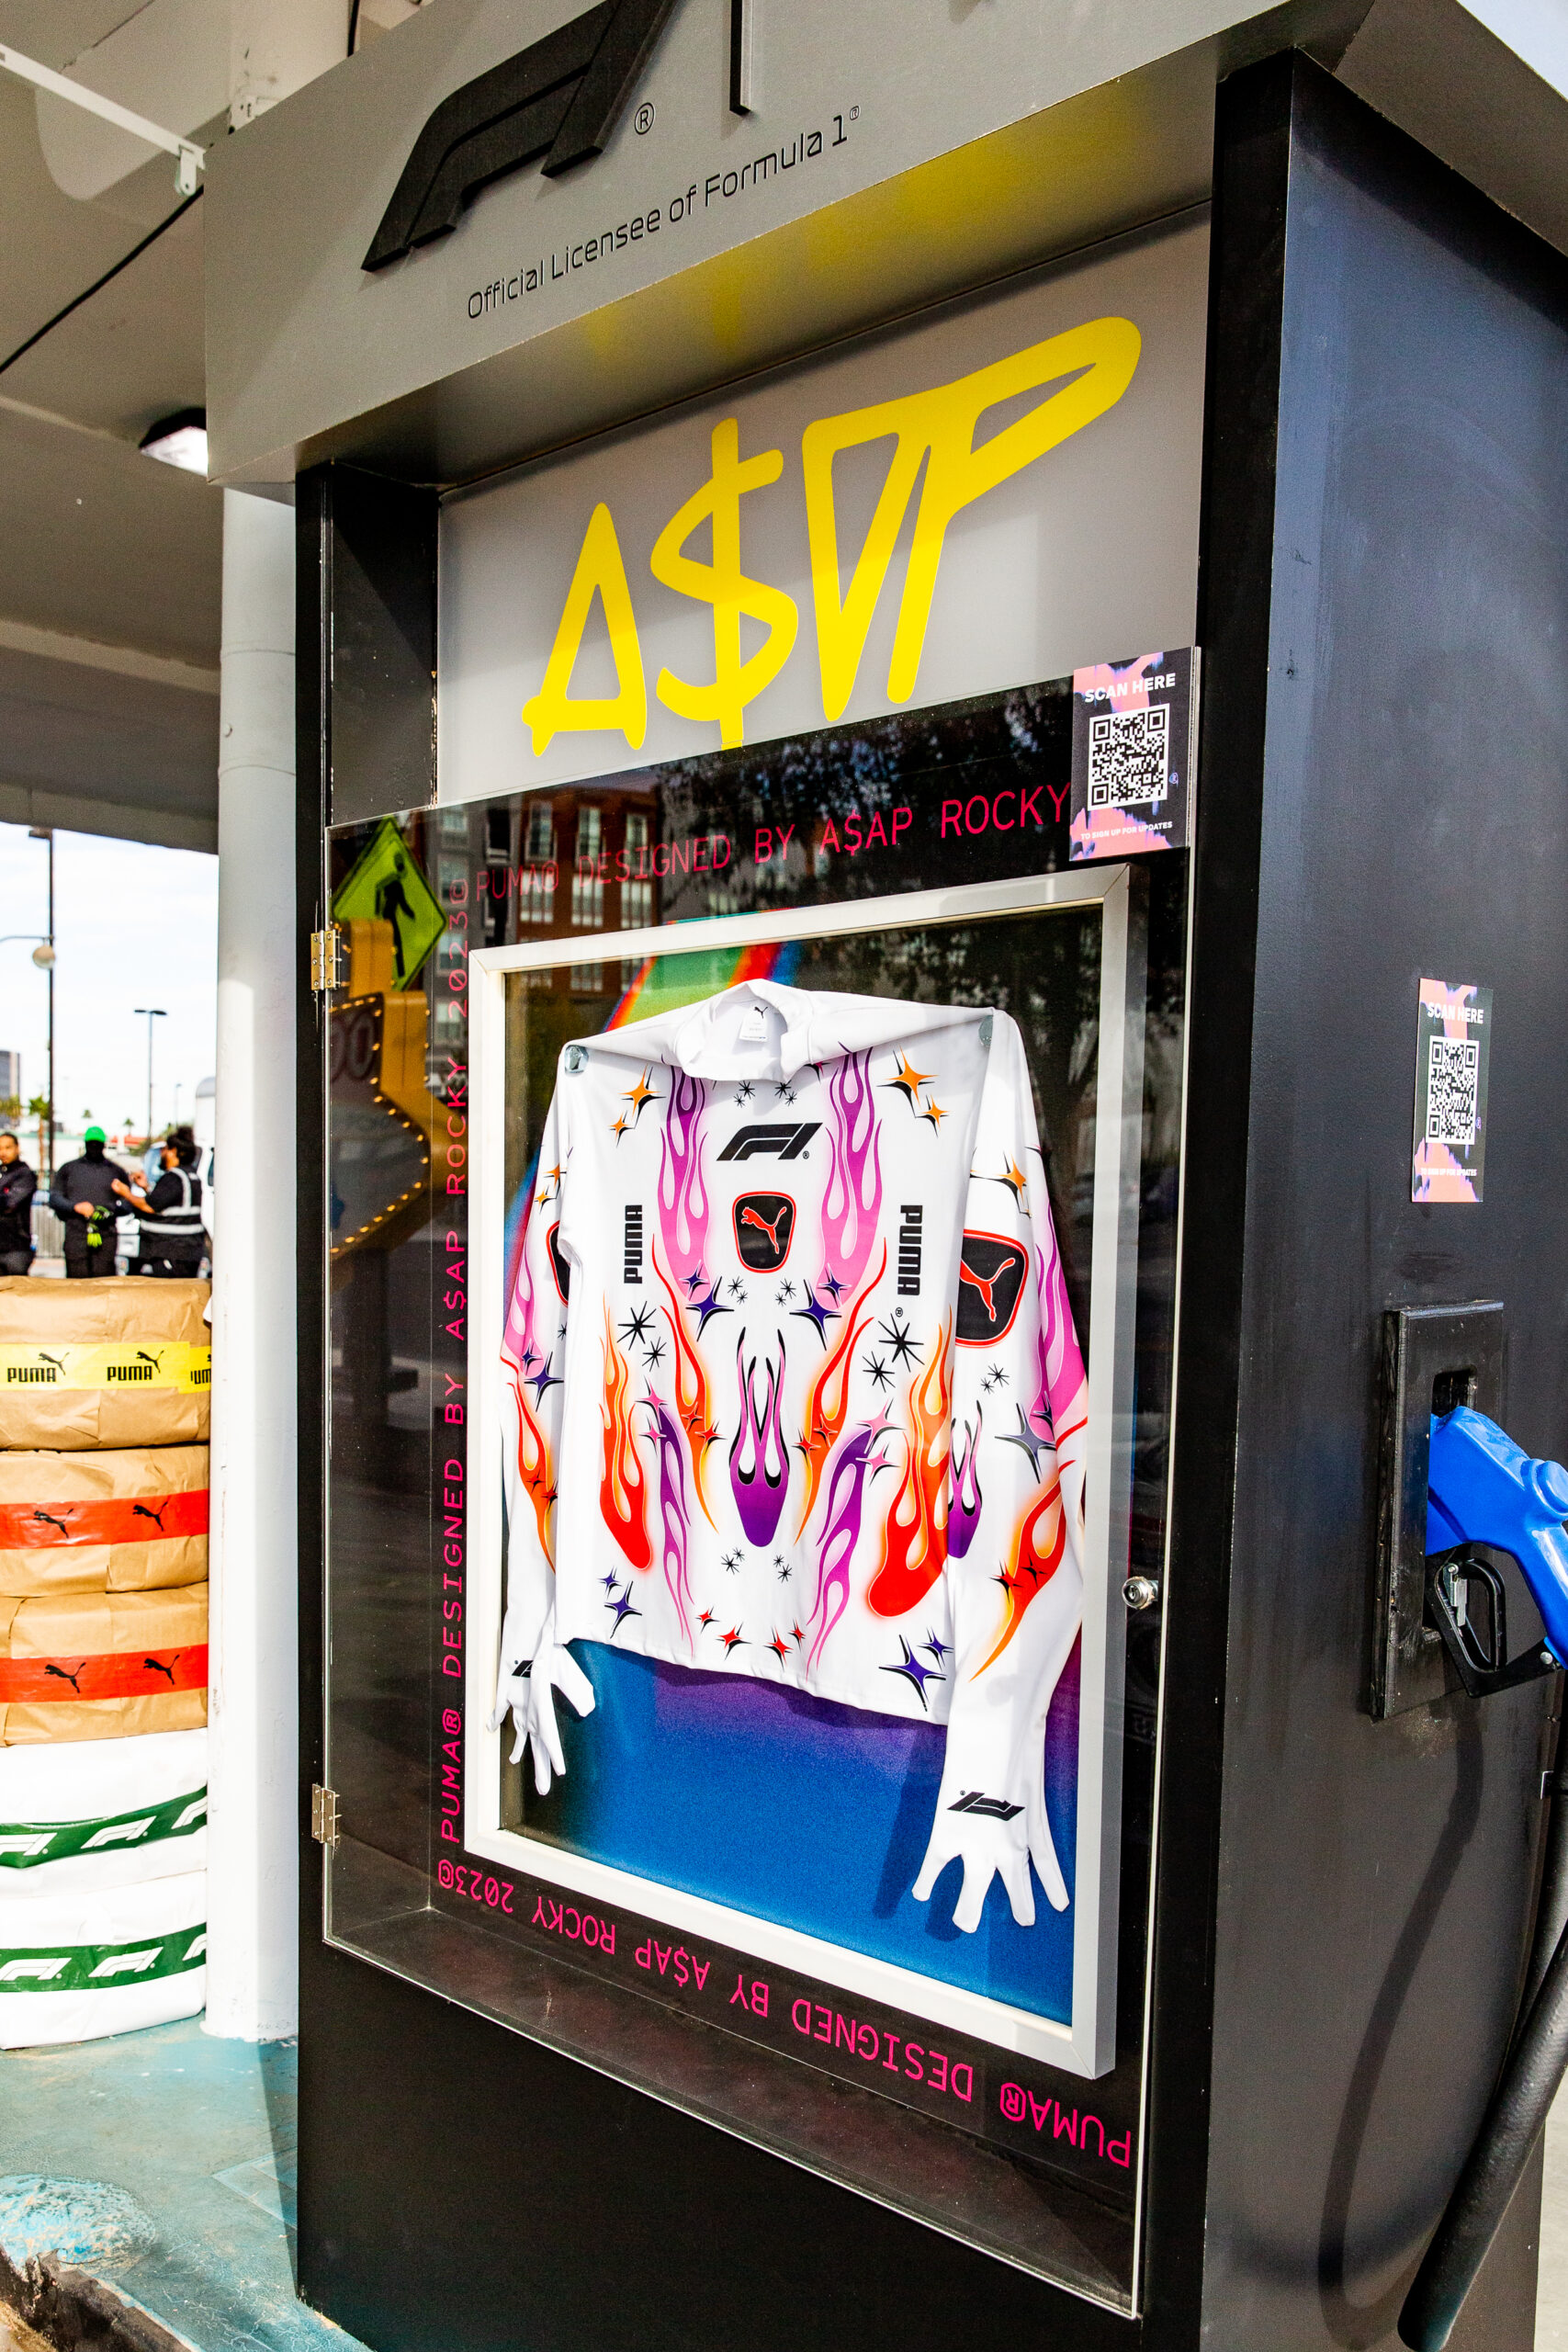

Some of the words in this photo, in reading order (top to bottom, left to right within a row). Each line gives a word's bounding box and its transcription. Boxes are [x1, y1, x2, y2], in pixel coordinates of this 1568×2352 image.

[468, 260, 545, 319] Official
[552, 209, 660, 279] Licensee
[670, 184, 696, 222] of
[705, 130, 822, 208] Formula
[1084, 682, 1129, 703] SCAN
[1132, 672, 1176, 695] HERE
[578, 834, 731, 888] DESIGNED
[755, 823, 795, 864] BY
[818, 807, 913, 857] A$AP
[941, 782, 1071, 839] ROCKY
[1080, 832, 1091, 841] TO
[1092, 830, 1110, 840] SIGN
[1111, 828, 1122, 837] UP
[1122, 826, 1137, 835] FOR
[1138, 820, 1173, 832] UPDATES
[1427, 1001, 1456, 1022] SCAN
[1457, 1006, 1483, 1024] HERE
[446, 1057, 468, 1195] ROCKY
[624, 1204, 643, 1284] PUMA
[443, 1230, 468, 1341] A$AP
[7, 1367, 57, 1383] PUMA
[107, 1365, 152, 1381] PUMA
[445, 1373, 465, 1426] BY
[442, 1458, 464, 1679] DESIGNED
[441, 1707, 462, 1843] PUMA®
[531, 1895, 616, 1955] ROCKY
[635, 1938, 711, 1991] A$AP
[729, 1973, 770, 2018] BY
[792, 1998, 974, 2103] DESIGNED
[999, 2082, 1132, 2168] PUMA®
